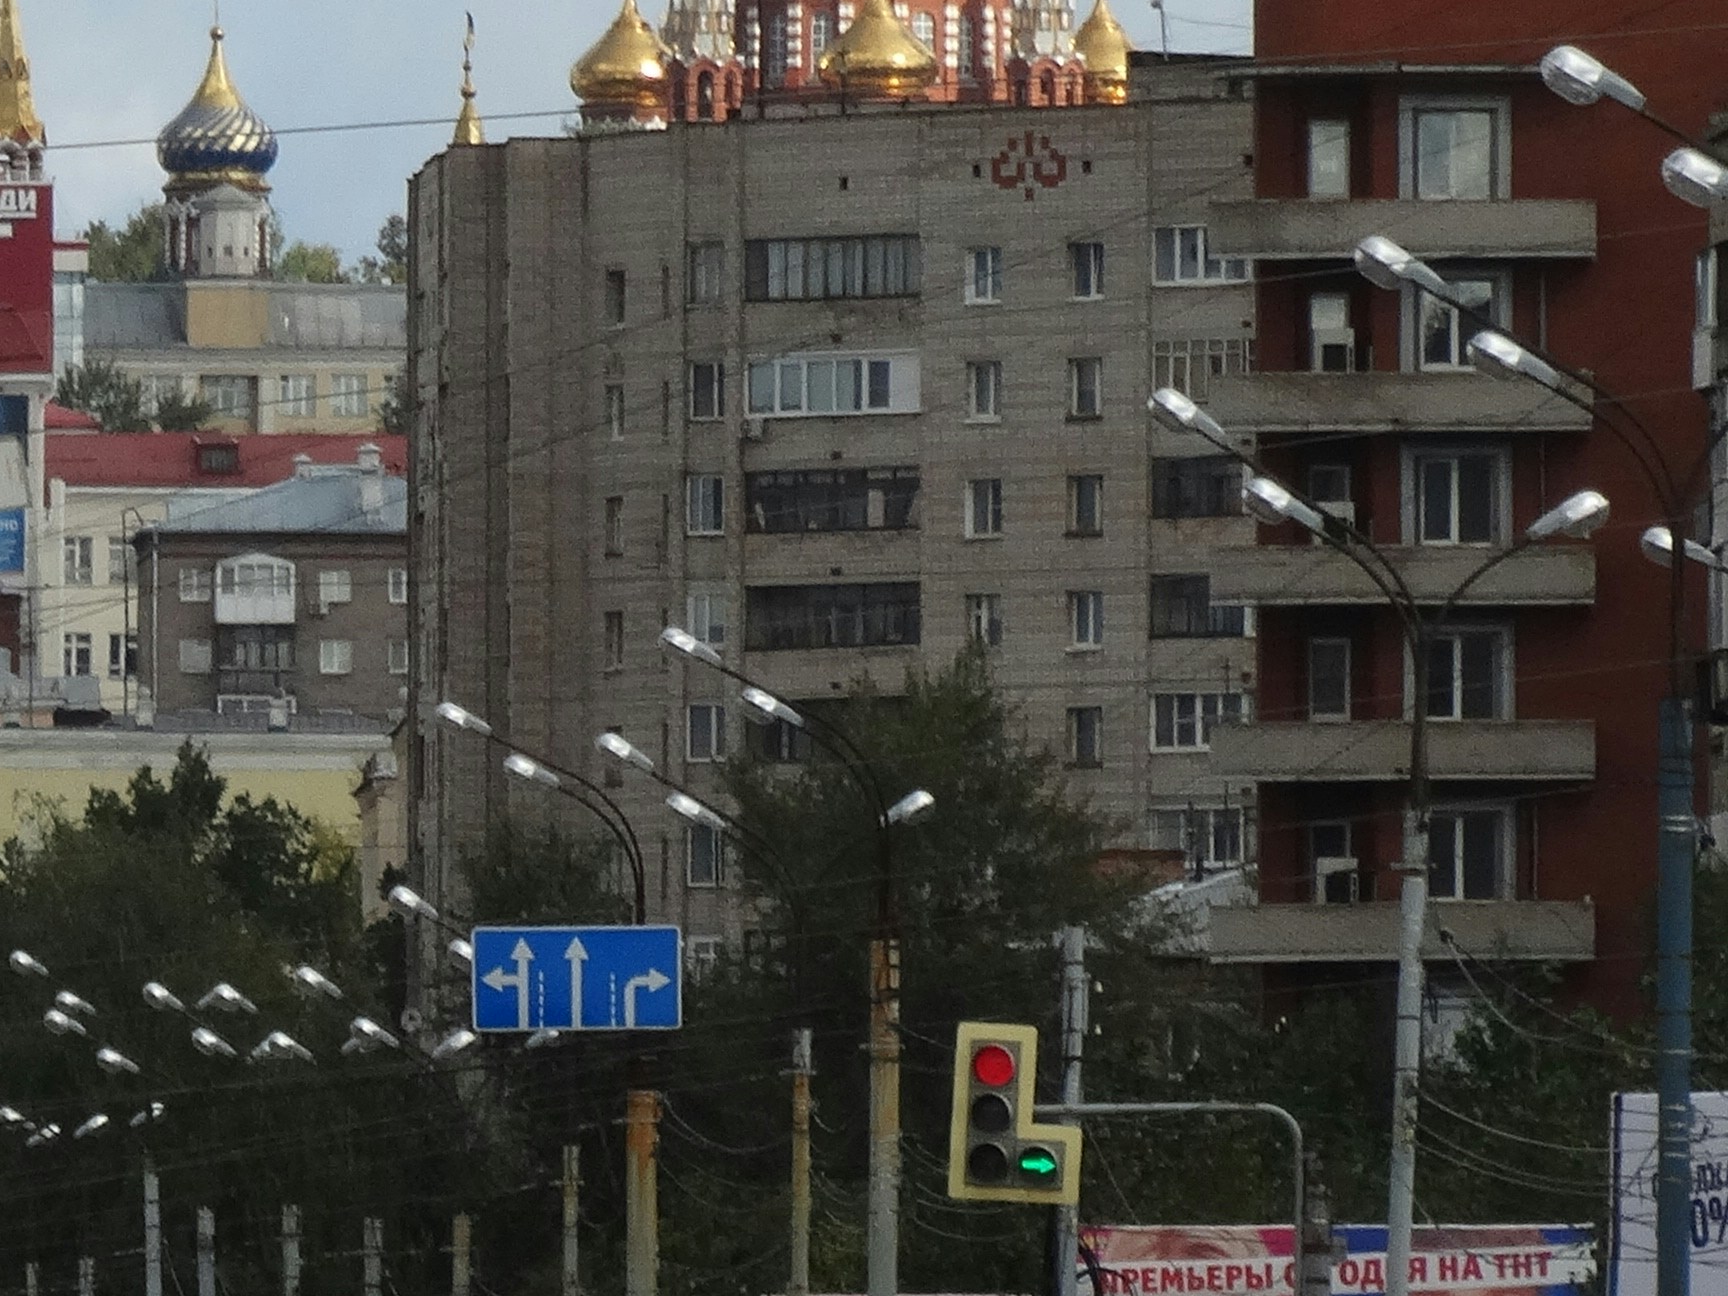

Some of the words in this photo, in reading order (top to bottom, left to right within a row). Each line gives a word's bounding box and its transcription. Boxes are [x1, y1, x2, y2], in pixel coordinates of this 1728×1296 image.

[1099, 1262, 1274, 1295] ПРЕМЬЕРЫ
[1439, 1258, 1482, 1281] НА
[1495, 1253, 1551, 1279] ТНТ
